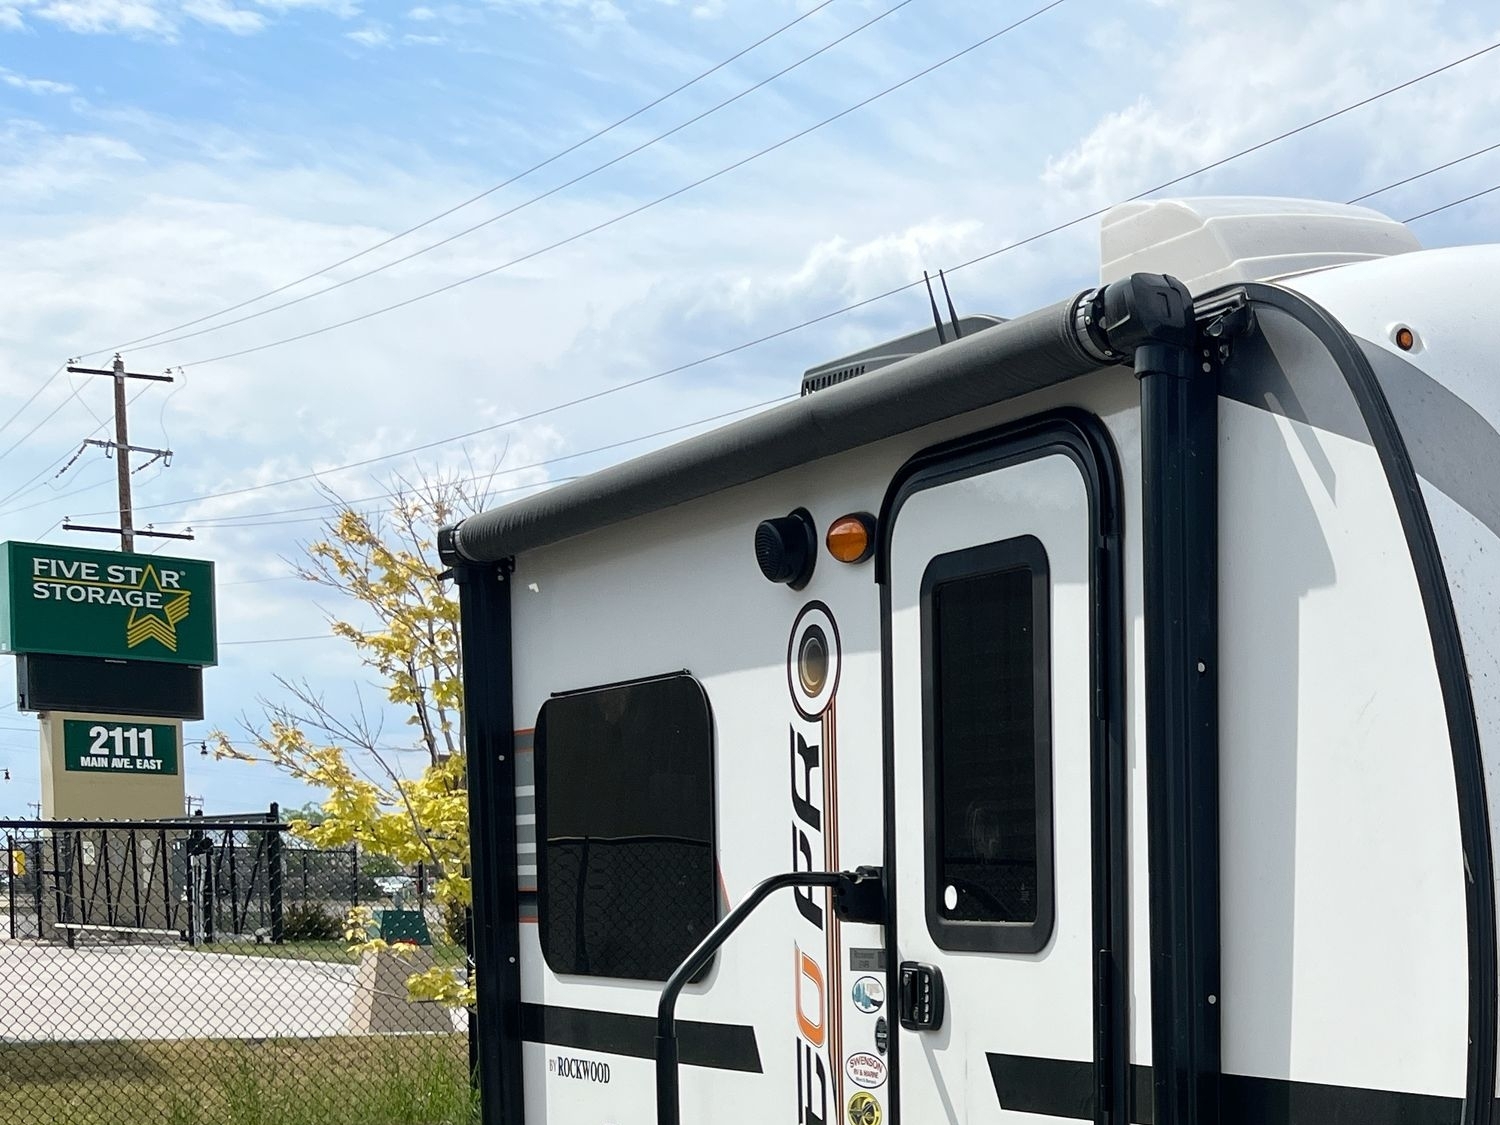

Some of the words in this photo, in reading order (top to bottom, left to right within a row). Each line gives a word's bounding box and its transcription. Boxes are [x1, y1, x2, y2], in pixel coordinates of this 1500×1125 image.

[32, 557, 100, 581] FIVE
[32, 582, 164, 609] STORAGE
[89, 725, 154, 757] 2111
[80, 756, 109, 768] MAIN
[111, 757, 134, 769] AVE.
[136, 758, 163, 770] EAST
[549, 1059, 557, 1072] BY
[557, 1056, 611, 1084] ROCKWOOD
[849, 1056, 883, 1073] SWENSON
